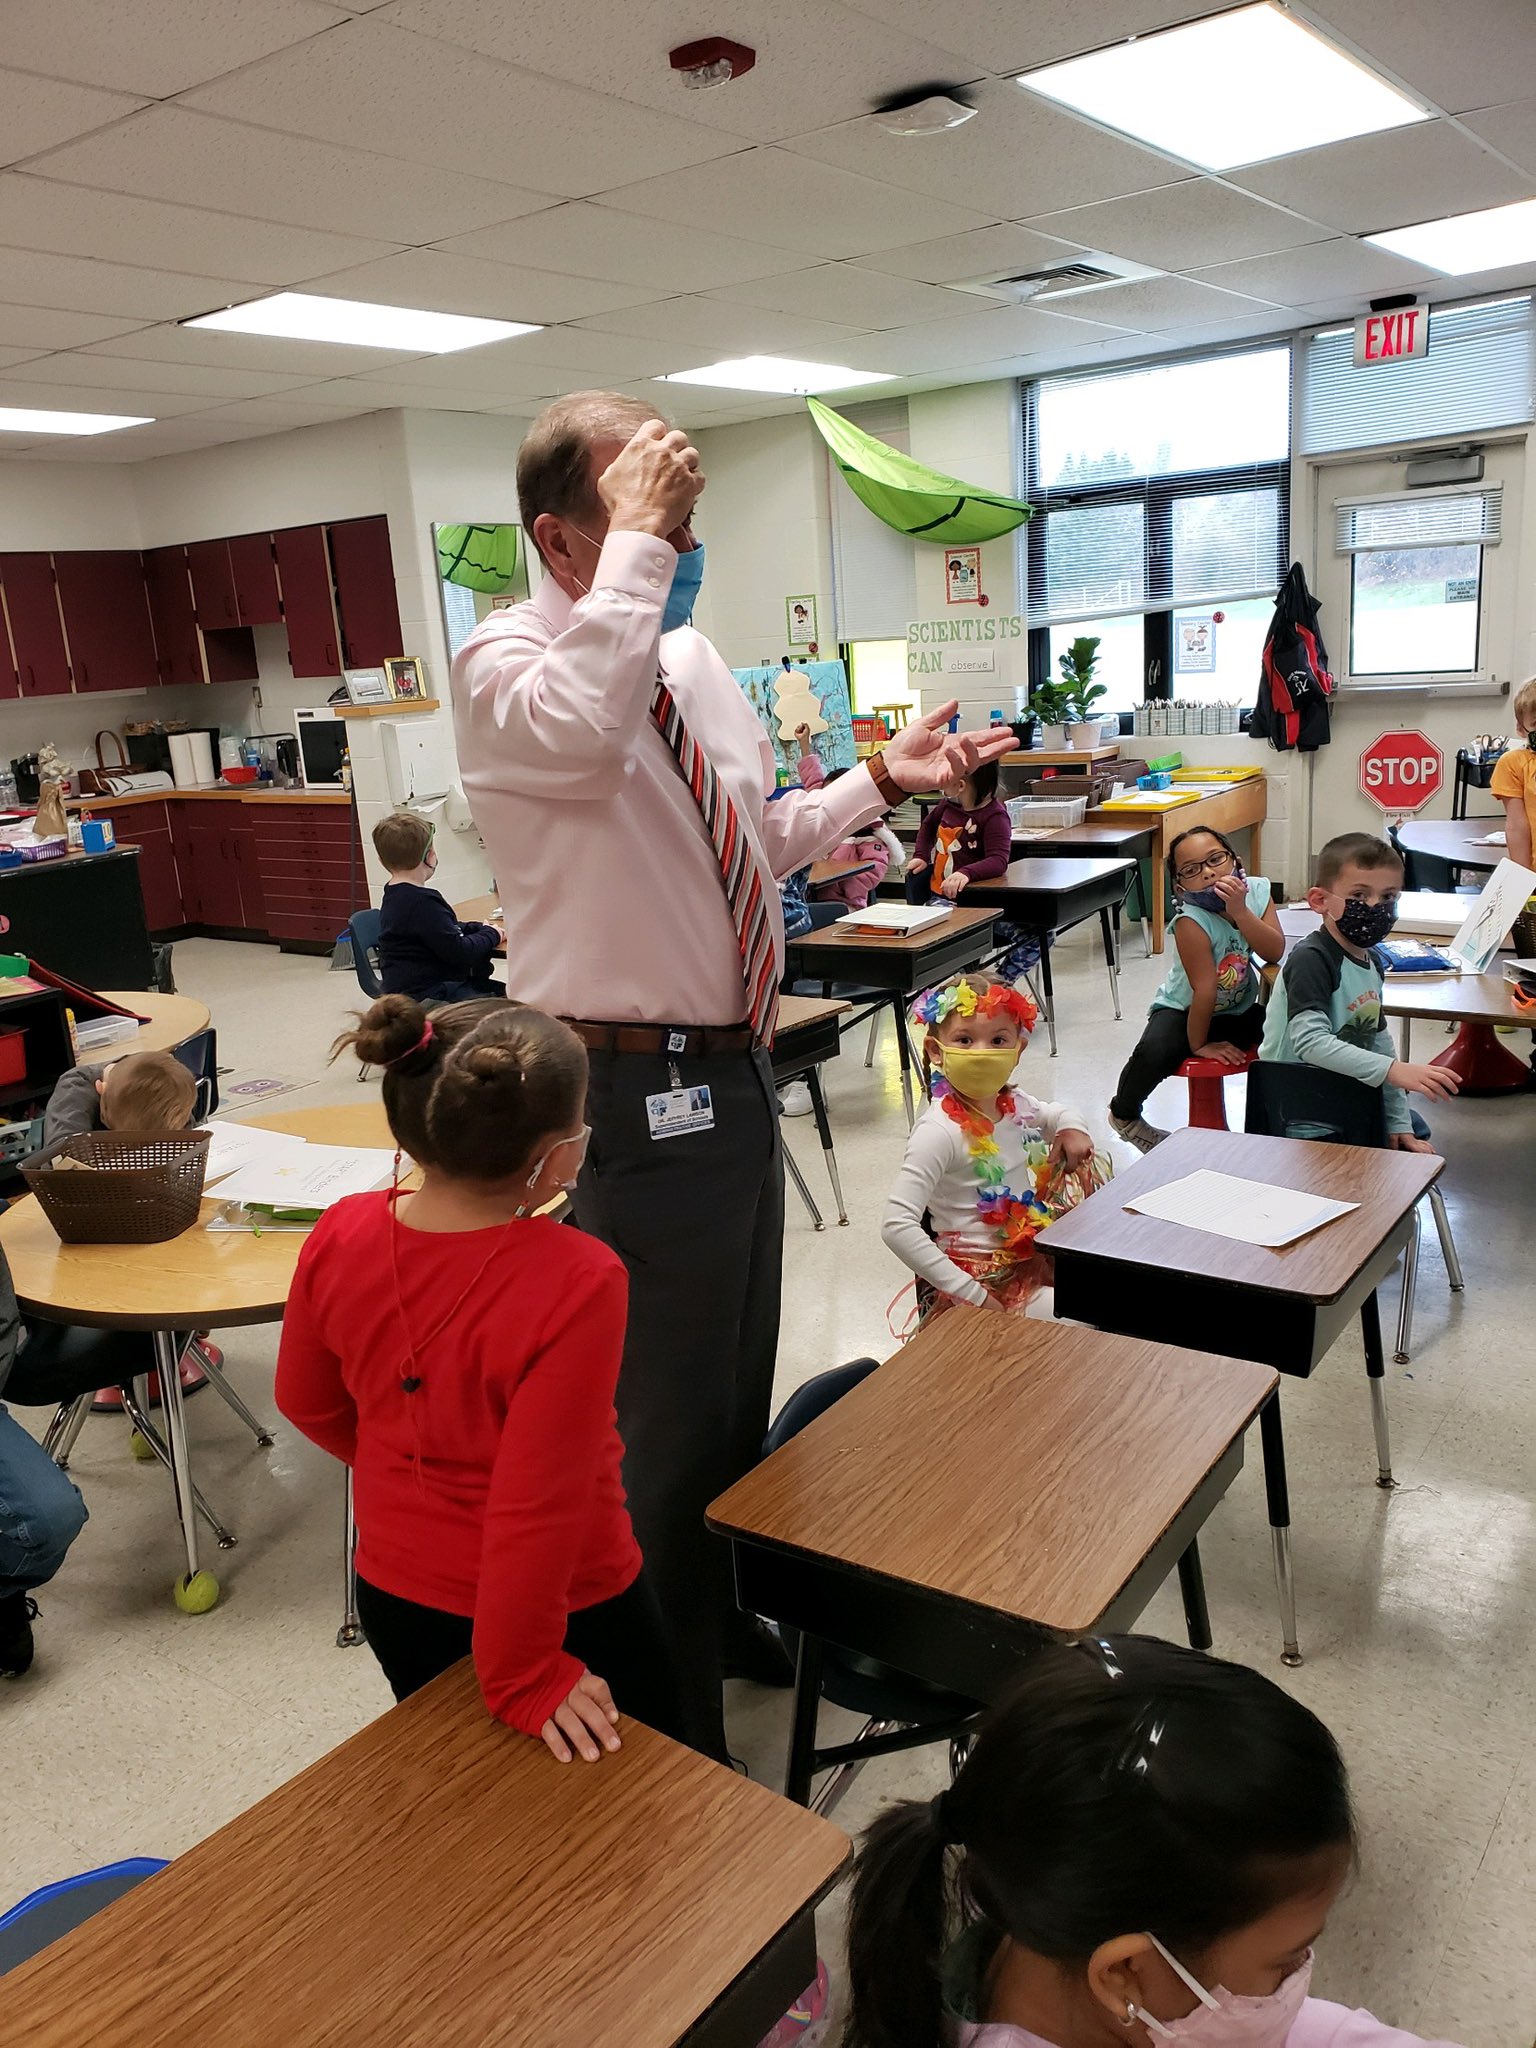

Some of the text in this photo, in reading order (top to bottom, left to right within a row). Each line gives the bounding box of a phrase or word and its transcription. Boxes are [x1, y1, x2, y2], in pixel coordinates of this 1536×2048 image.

[1366, 310, 1420, 360] EXIT
[909, 616, 1021, 644] SCIENTISTS
[908, 651, 943, 673] CAN
[950, 659, 988, 671] observe
[1366, 757, 1438, 787] STOP
